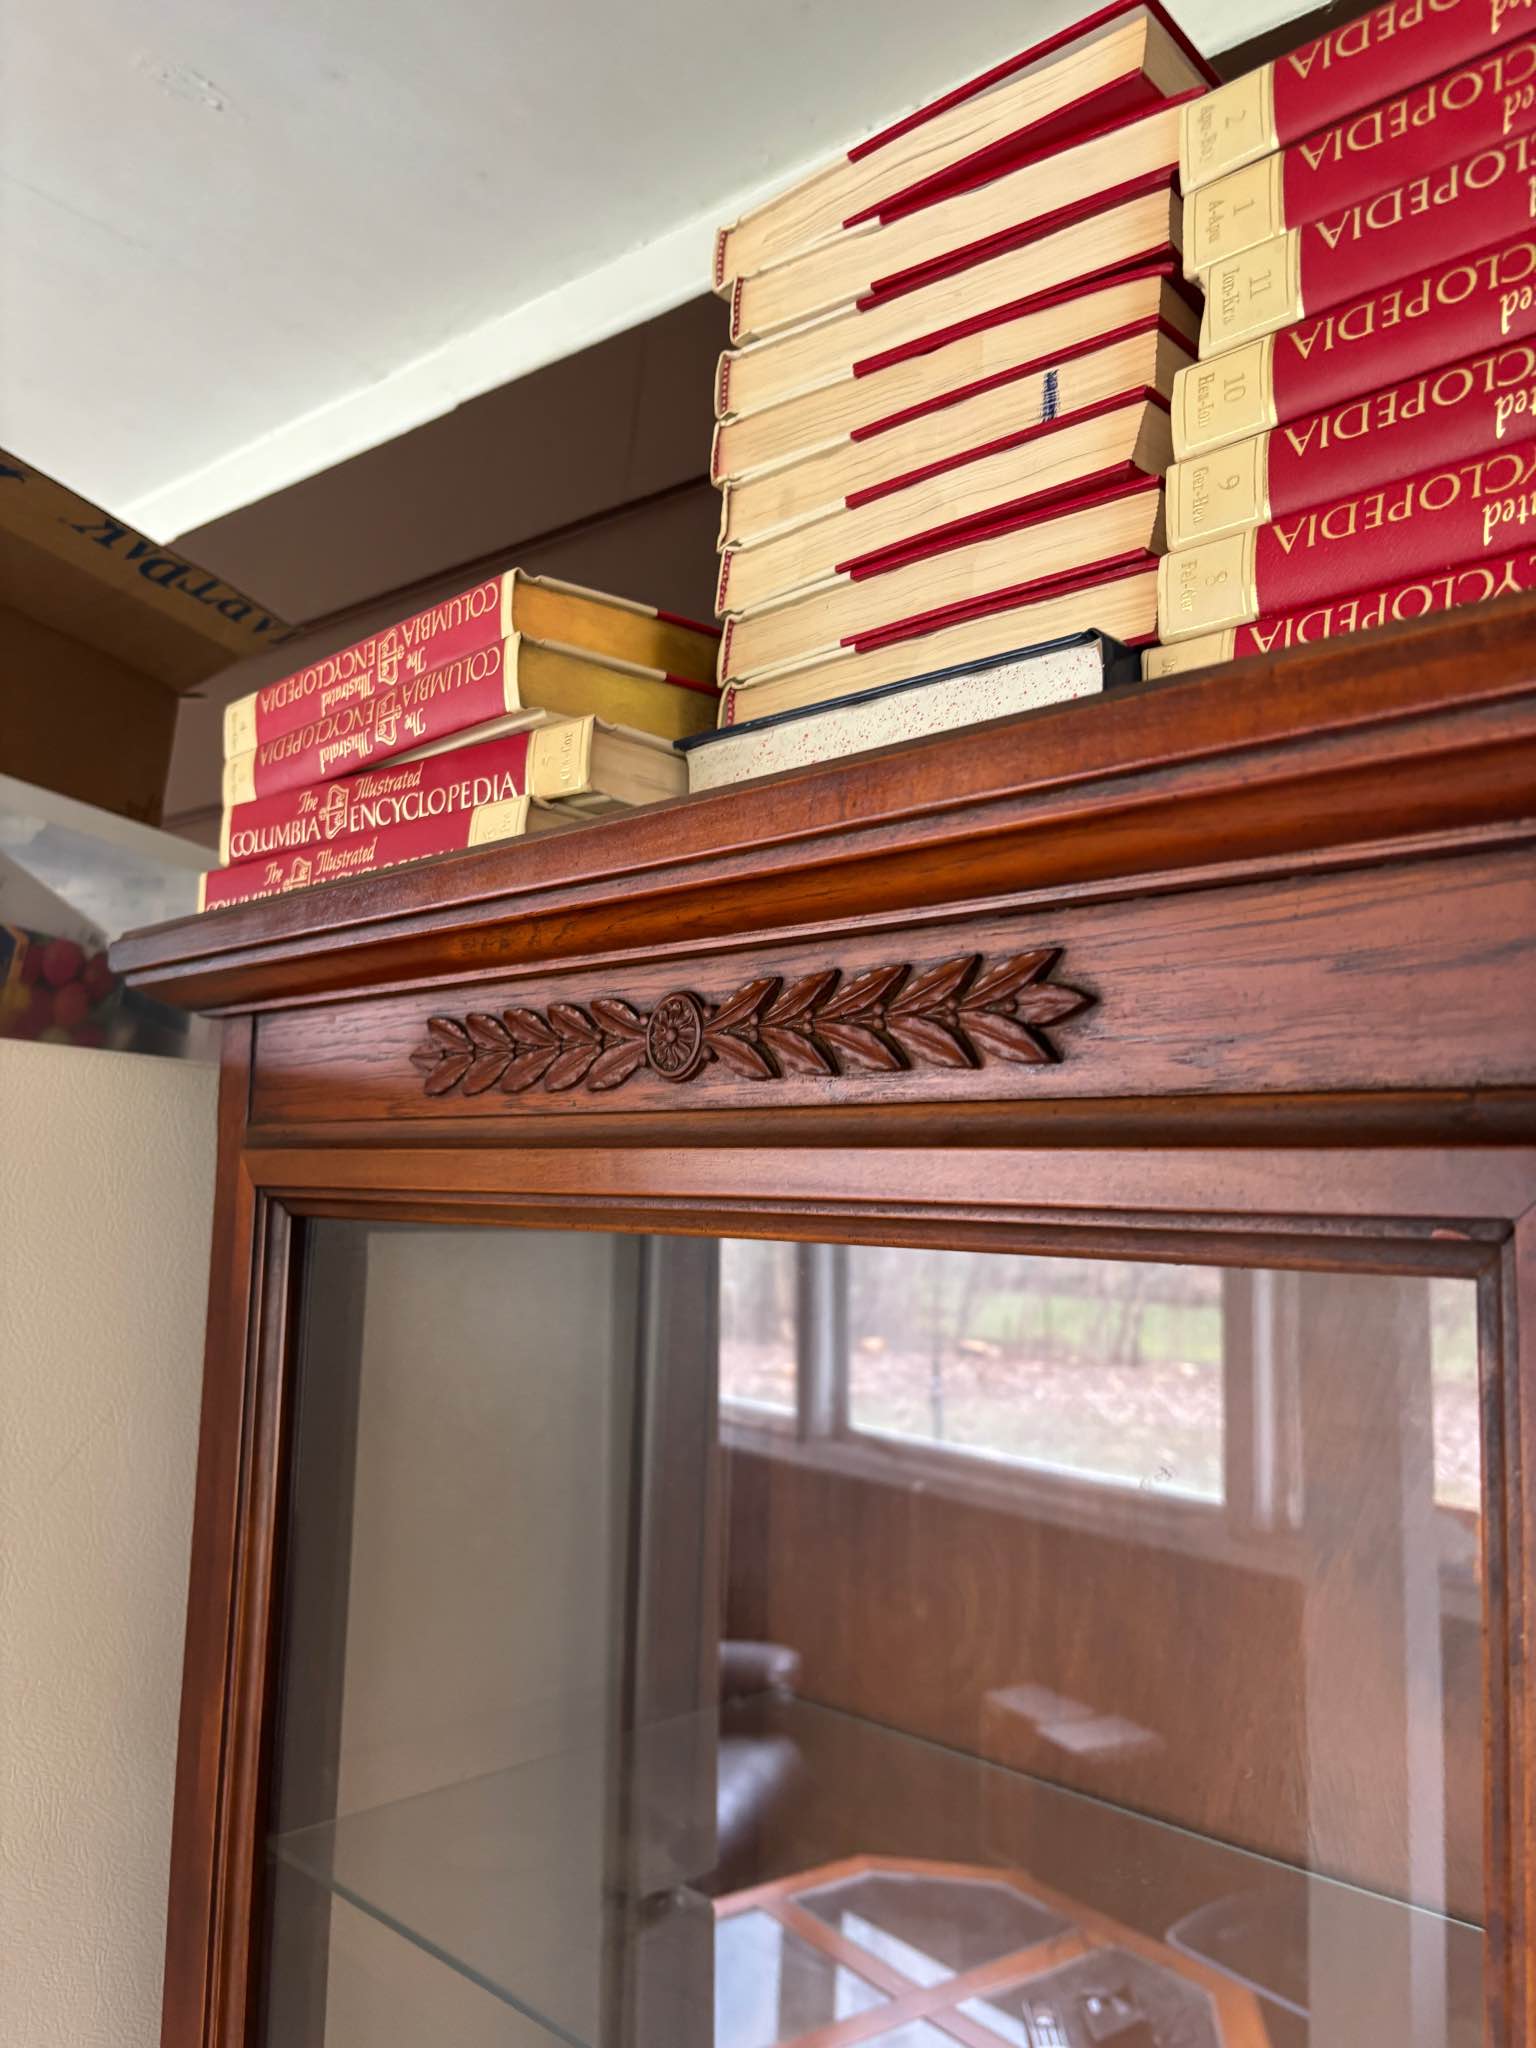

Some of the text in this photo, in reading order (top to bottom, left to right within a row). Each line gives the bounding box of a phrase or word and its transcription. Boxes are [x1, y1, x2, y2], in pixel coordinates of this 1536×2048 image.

[261, 581, 499, 712] COLUMBIA ENCYCLOPEDIA
[402, 646, 501, 708] COLUMBIA
[319, 645, 429, 718] The Illustrated
[259, 703, 375, 767] ENCYCLOPEDIA
[319, 707, 427, 775] The Illustrated
[229, 815, 322, 860] COLUMBIA
[349, 770, 519, 833] ENCYCLOPEDIA
[297, 761, 422, 815] The Illustrated
[264, 862, 284, 886] The
[315, 837, 380, 875] Illustrated
